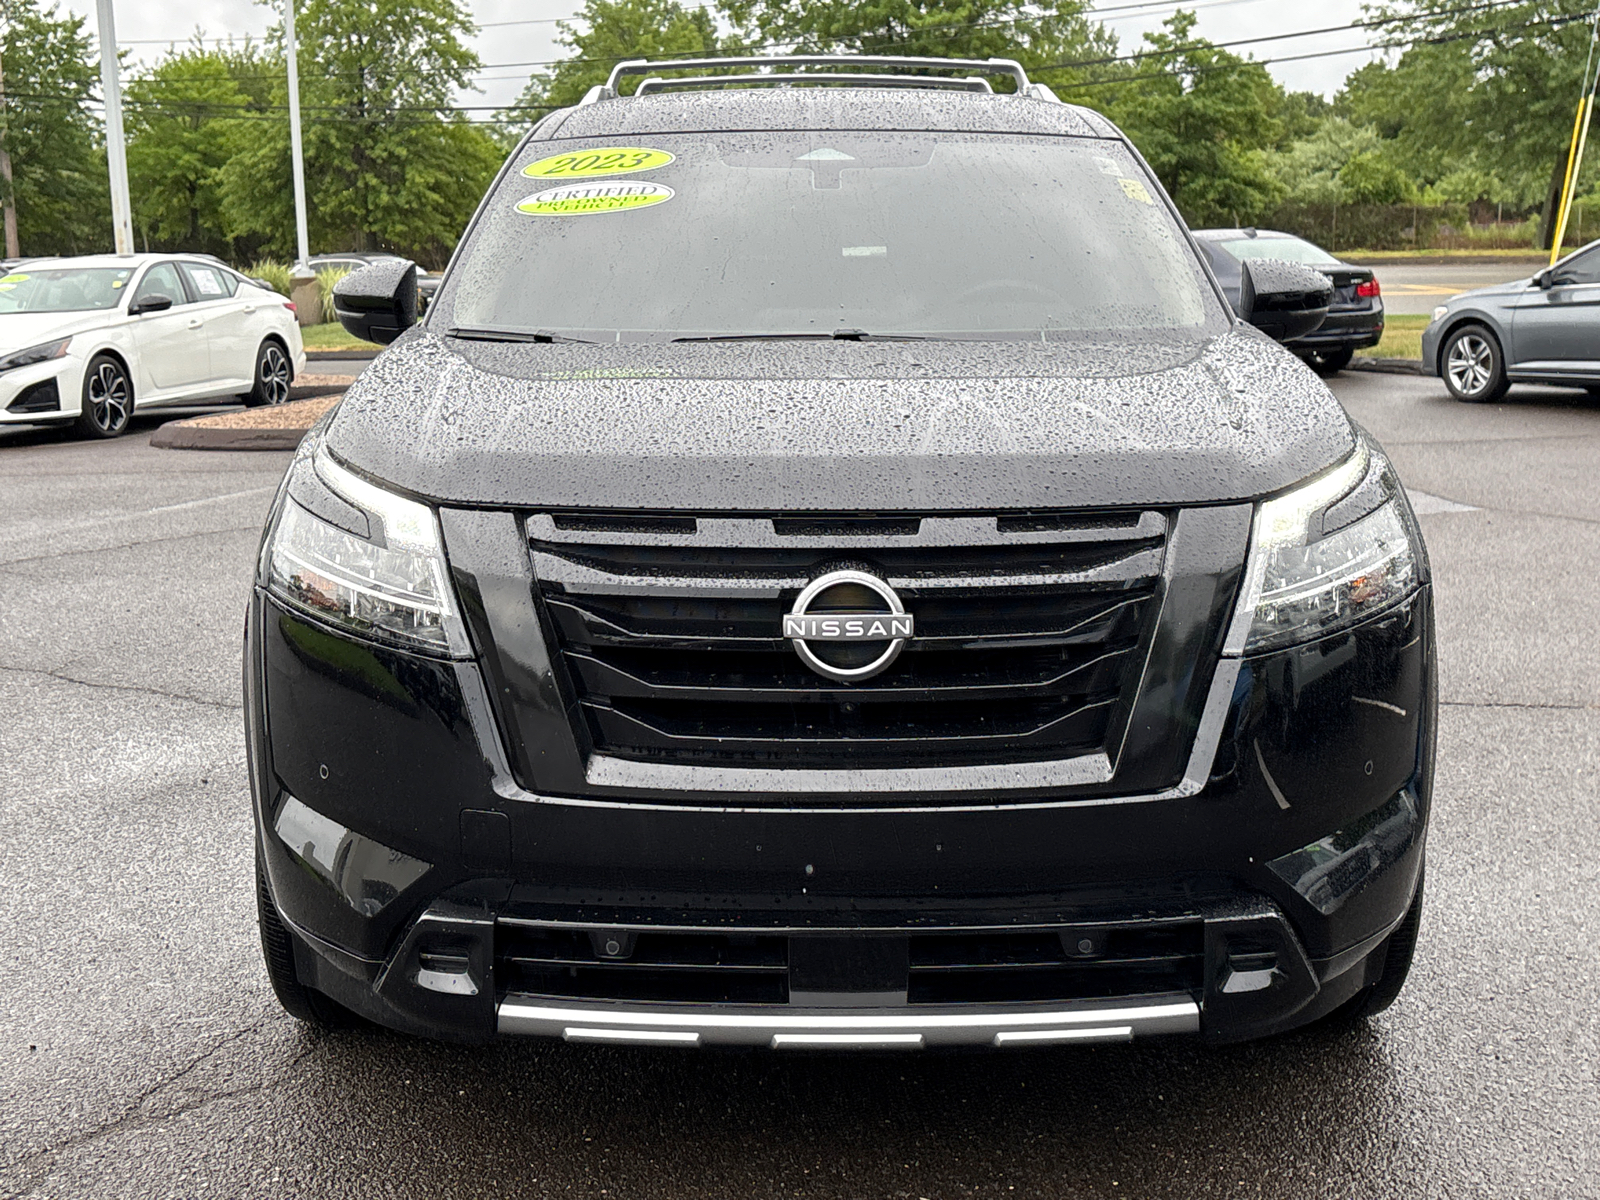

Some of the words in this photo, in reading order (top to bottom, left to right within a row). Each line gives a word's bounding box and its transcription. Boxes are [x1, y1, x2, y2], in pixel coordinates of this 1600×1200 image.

[542, 152, 653, 175] 2023
[536, 186, 658, 203] CERTIFIED
[552, 202, 627, 212] VEHICLE
[786, 619, 910, 636] NISSAN
